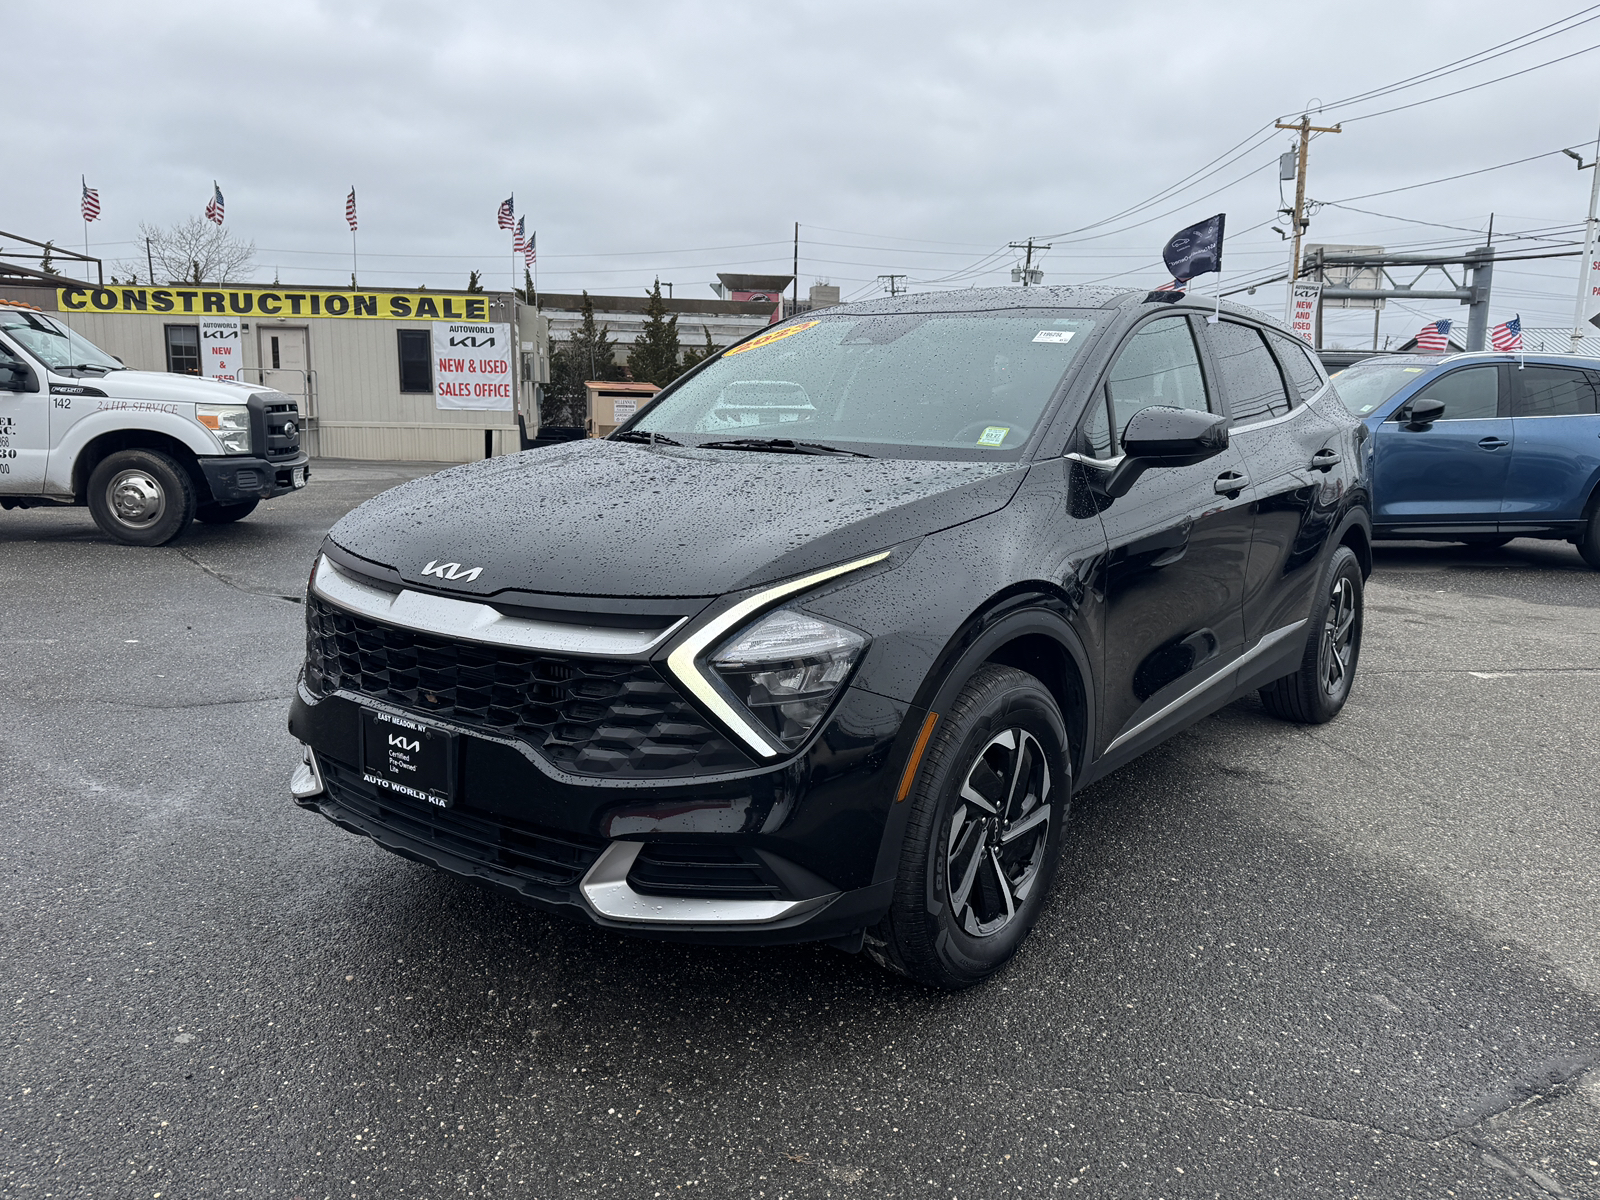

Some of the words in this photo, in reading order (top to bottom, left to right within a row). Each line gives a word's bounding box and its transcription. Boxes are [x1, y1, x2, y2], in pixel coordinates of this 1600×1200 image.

[1294, 290, 1319, 298] KIA
[61, 288, 378, 317] CONSTRUCTION
[389, 296, 486, 320] SALE
[1296, 301, 1313, 309] NEW
[1295, 311, 1311, 320] AND
[449, 325, 495, 334] AUTOWORLD
[1292, 321, 1311, 330] USED
[203, 330, 239, 339] KIA
[449, 336, 496, 348] KIA
[211, 346, 232, 355] NEW
[219, 361, 226, 369] &
[439, 358, 465, 373] NEW
[468, 359, 477, 374] &
[480, 359, 508, 374] USED
[438, 382, 471, 397] SALES
[473, 383, 511, 398] OFFICE
[53, 397, 72, 409] 142
[96, 400, 109, 411] 24
[110, 400, 130, 412] HR.
[131, 401, 179, 415] SERVICE
[421, 559, 484, 583] KIA
[377, 712, 391, 723] EAST
[417, 724, 426, 733] NY
[388, 733, 420, 753] KIA
[388, 749, 410, 762] Certified
[389, 764, 399, 774] Lite
[363, 774, 389, 788] AUTO
[391, 783, 426, 800] WORLD
[428, 795, 446, 808] KIA
